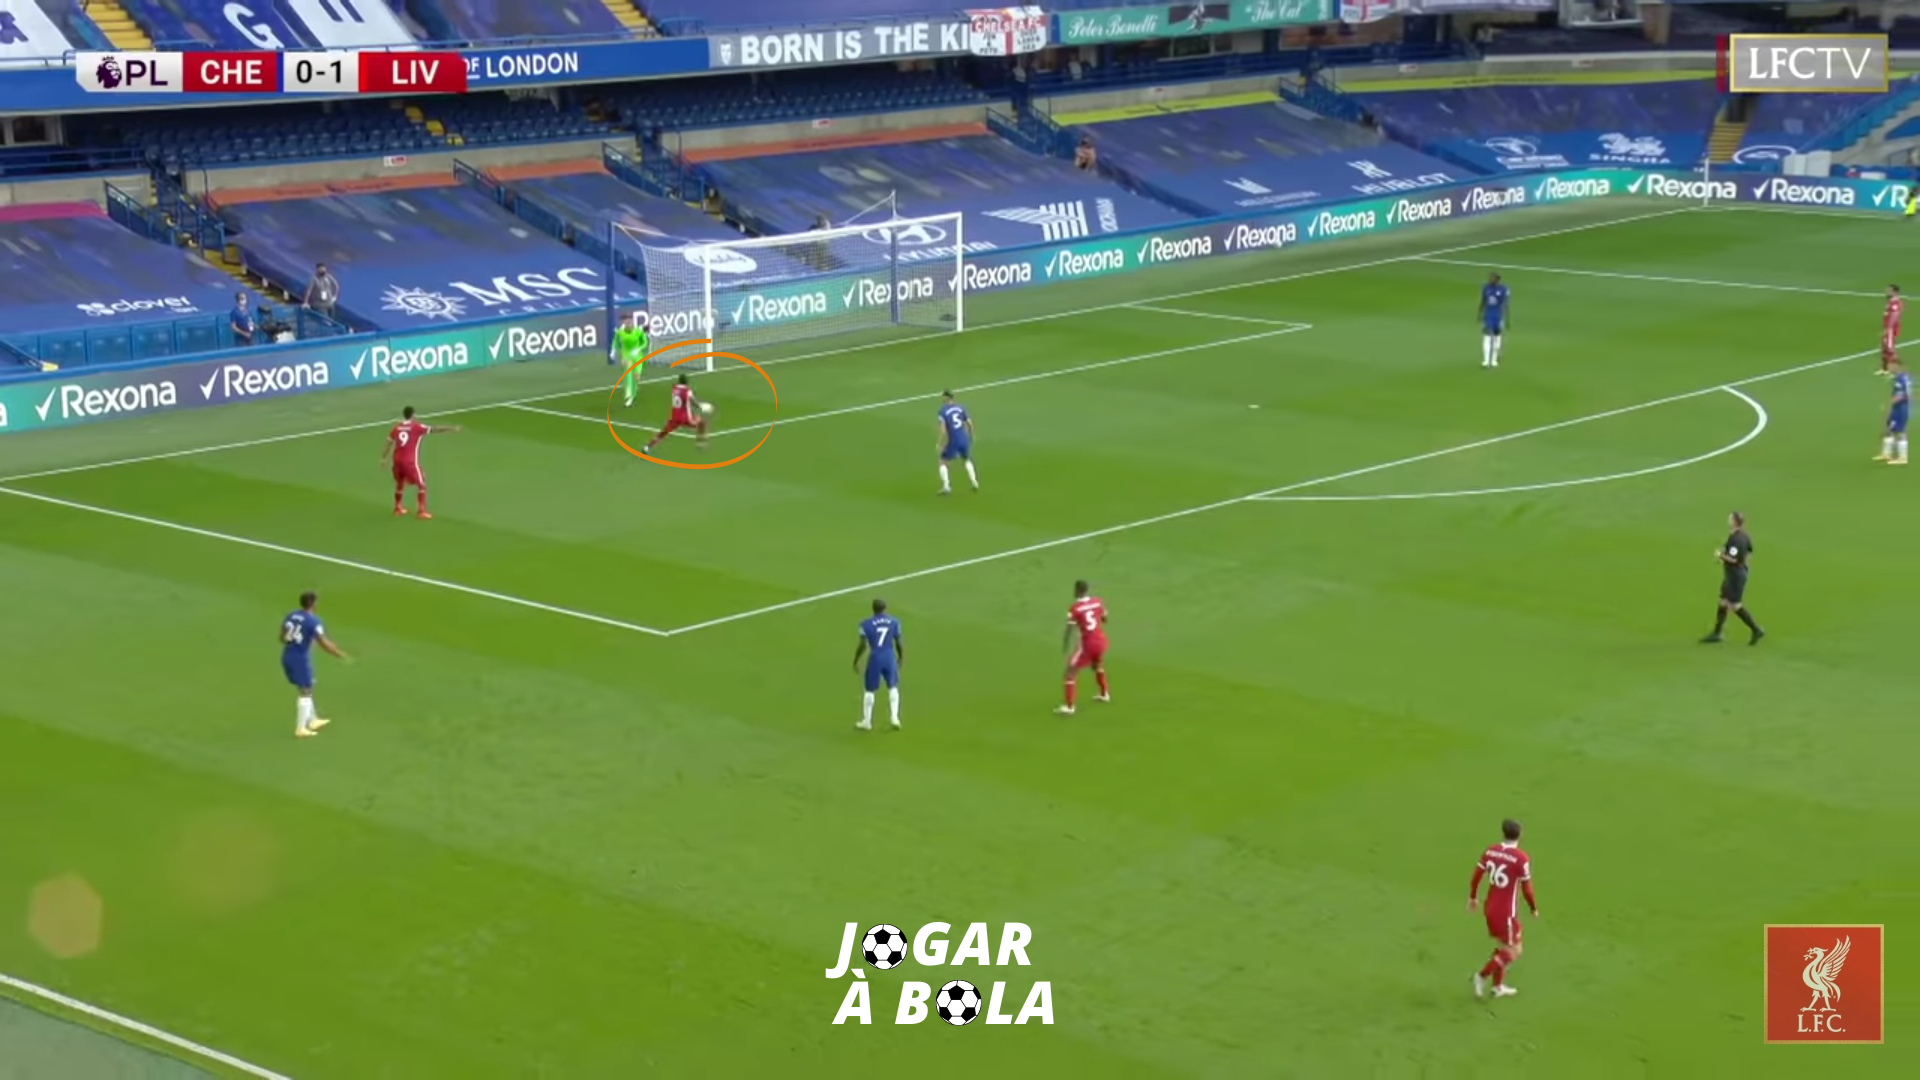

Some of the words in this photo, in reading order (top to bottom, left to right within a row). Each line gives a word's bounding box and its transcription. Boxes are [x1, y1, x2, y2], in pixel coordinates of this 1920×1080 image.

[1068, 15, 1102, 38] Peter
[741, 32, 824, 65] BORN
[836, 30, 862, 59] IS
[874, 23, 929, 55] THE
[941, 23, 970, 52] KI
[486, 52, 578, 78] LONDON
[1589, 153, 1671, 164] SINGHA
[1472, 185, 1525, 211] Rexona
[1546, 176, 1610, 199] Rexona
[1647, 174, 1737, 199] Rexona
[1771, 178, 1854, 204] Rexona
[1398, 197, 1451, 222] Rexona
[1236, 222, 1296, 249] Rexona
[1320, 210, 1375, 236] Rexona
[1059, 248, 1123, 276] Rexona
[1150, 235, 1212, 263] Rexona
[449, 267, 607, 306] MSC
[963, 263, 1031, 290] Rexona
[111, 296, 191, 313] clover
[749, 291, 827, 321] Rexona
[509, 324, 597, 356] Rexona
[372, 342, 468, 377] Rexona
[224, 360, 329, 397] Rexona
[61, 381, 176, 418] Rexona
[952, 412, 963, 429] 5
[398, 431, 409, 447] 9
[285, 620, 304, 644] 24
[1085, 611, 1097, 631] 5
[876, 627, 889, 647] 7
[1486, 860, 1509, 889] 26
